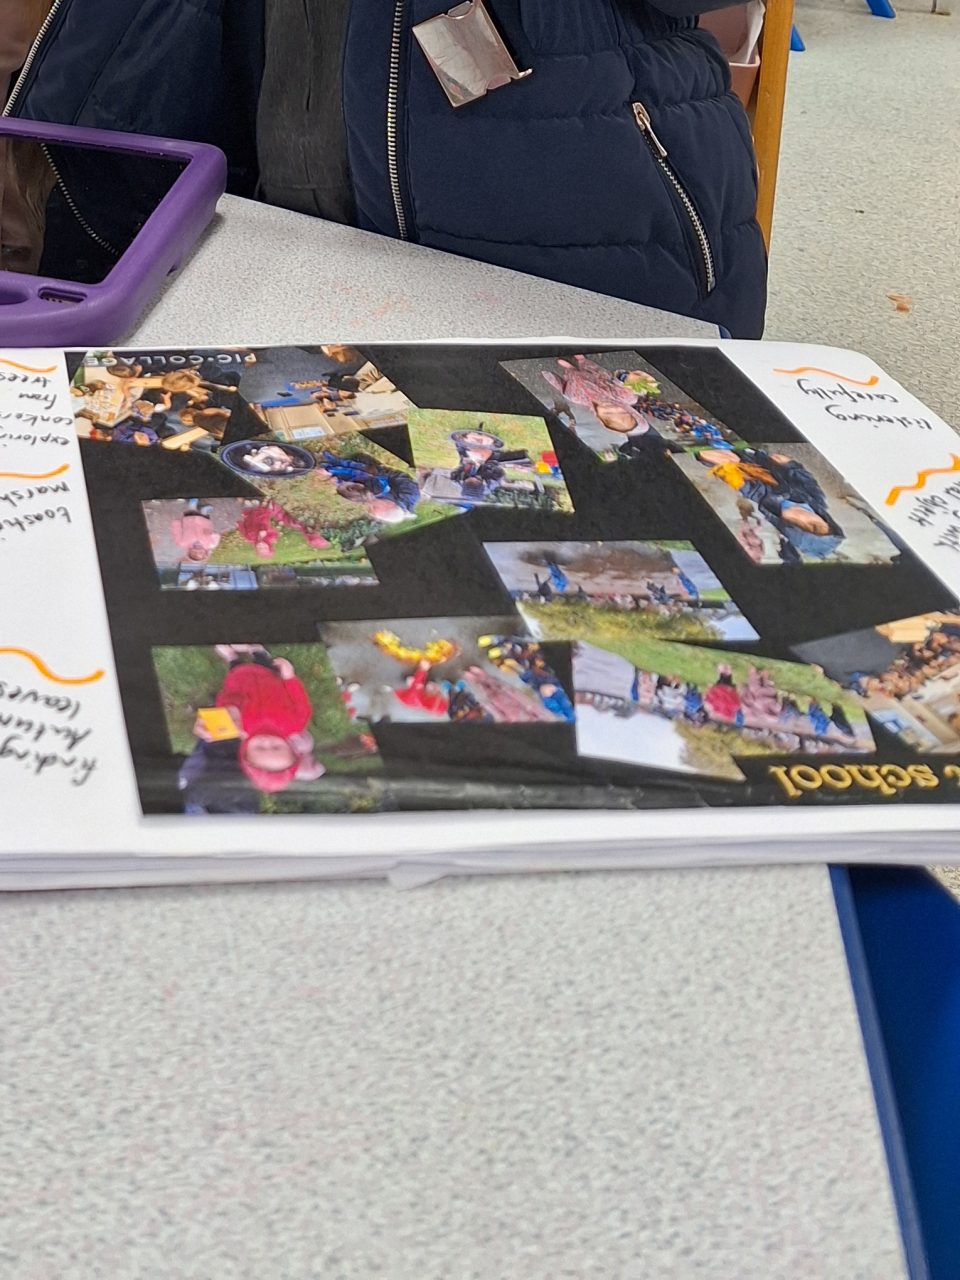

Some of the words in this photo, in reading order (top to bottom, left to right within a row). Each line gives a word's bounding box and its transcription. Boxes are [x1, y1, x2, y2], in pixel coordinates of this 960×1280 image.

[18, 393, 57, 411] from
[796, 378, 899, 403] carefully
[824, 404, 932, 431] listening
[767, 763, 939, 799] school
